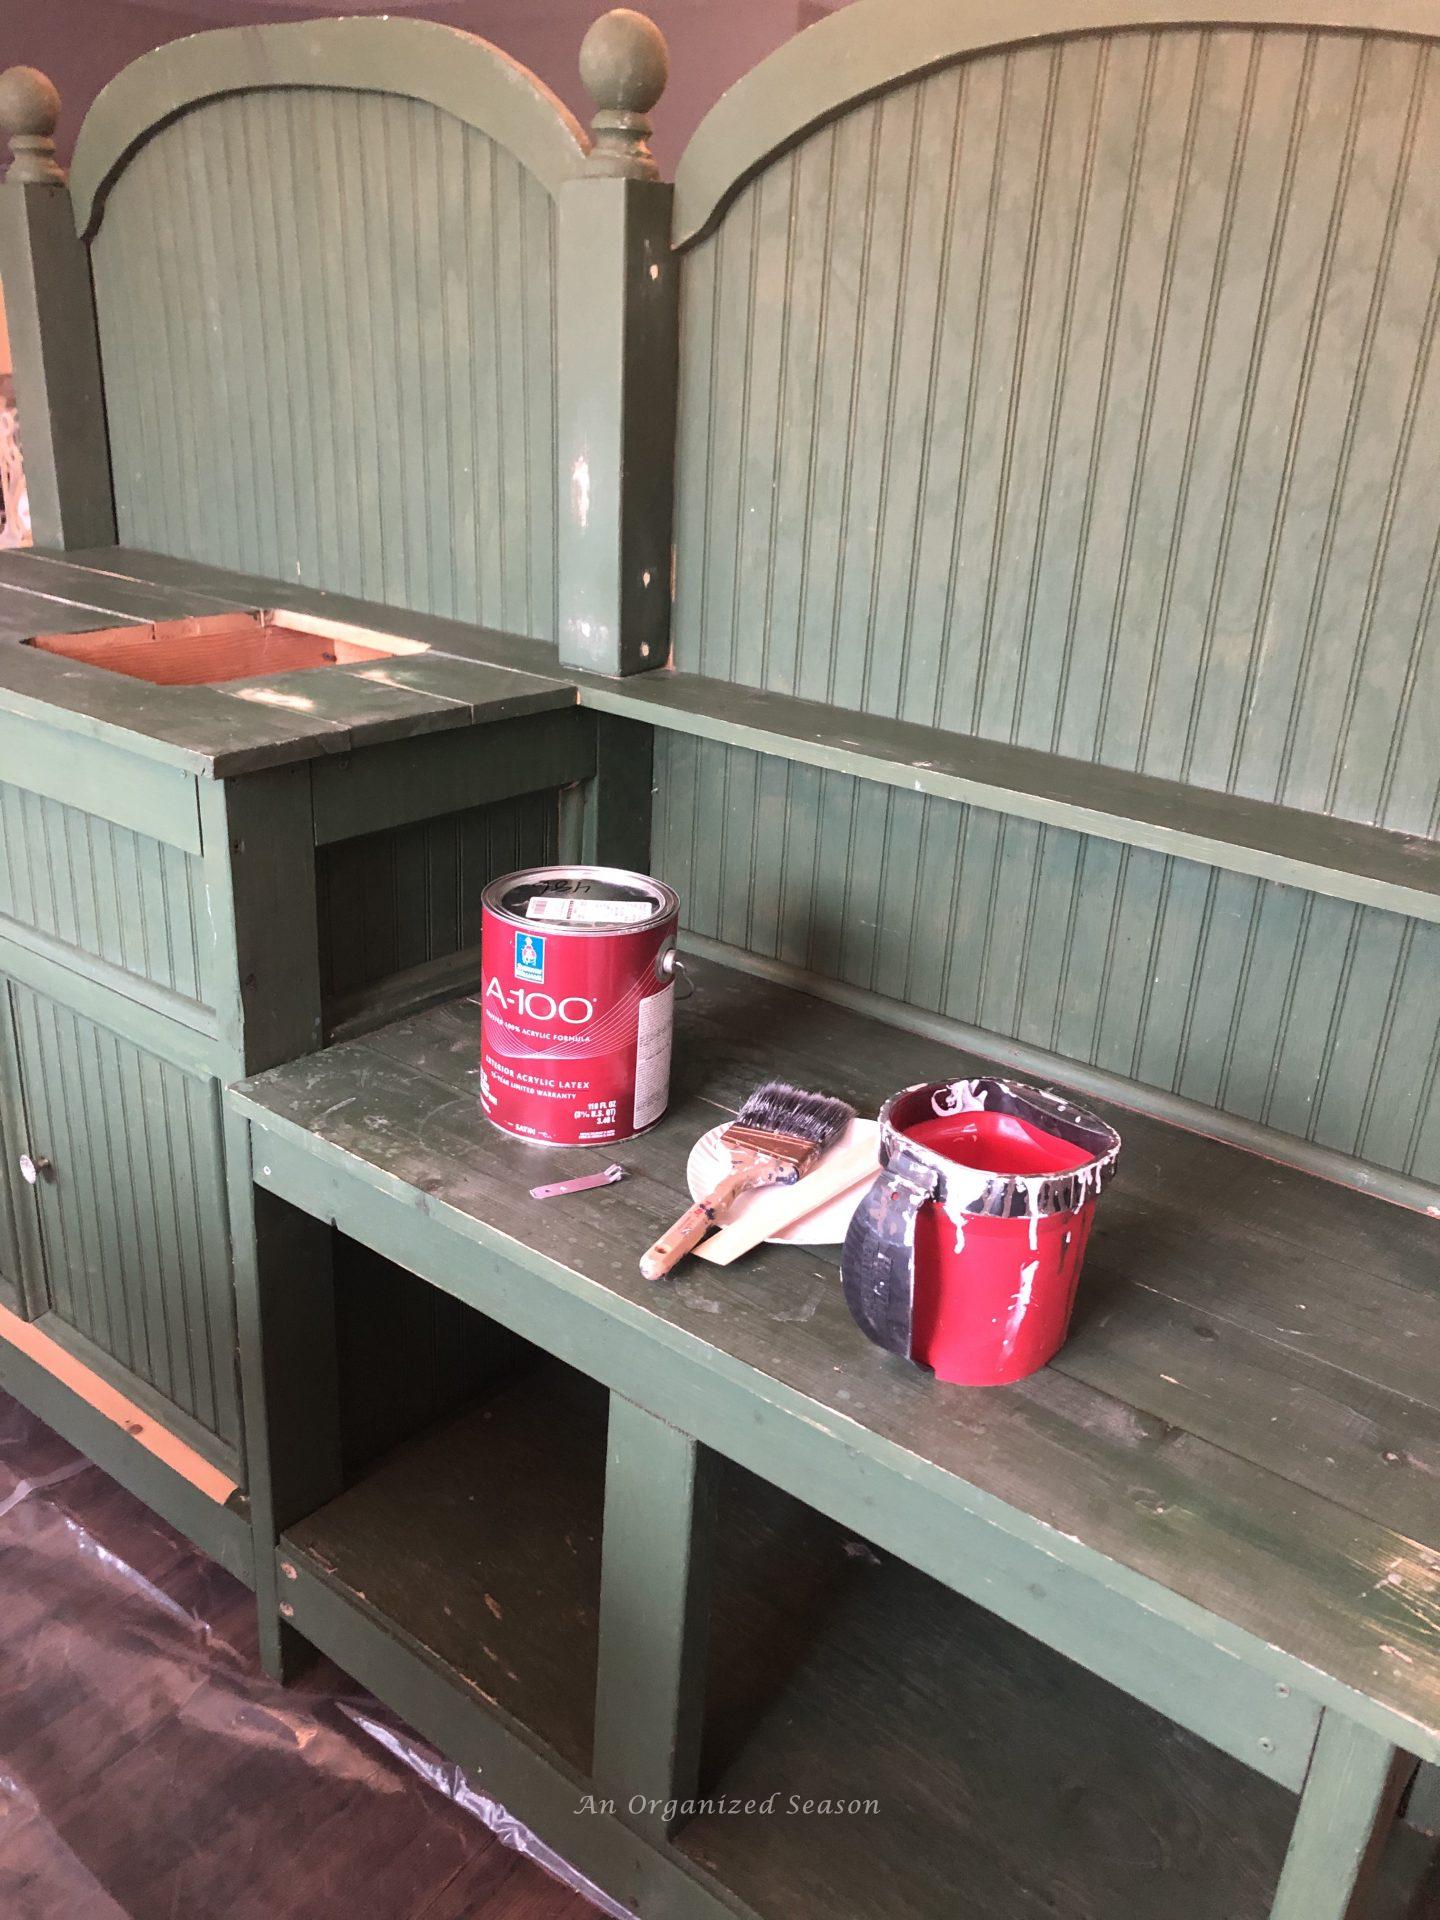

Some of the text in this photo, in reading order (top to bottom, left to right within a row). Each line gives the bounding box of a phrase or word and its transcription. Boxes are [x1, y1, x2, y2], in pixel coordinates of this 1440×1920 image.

[522, 1029, 551, 1040] ACRYLIC
[553, 1034, 590, 1042] FORMULA
[517, 1073, 554, 1087] ACRYLIC
[559, 1081, 590, 1089] LATEX
[511, 1081, 534, 1094] LIMITED
[537, 1089, 576, 1099] WARRANTY
[515, 1123, 536, 1135] SATIN
